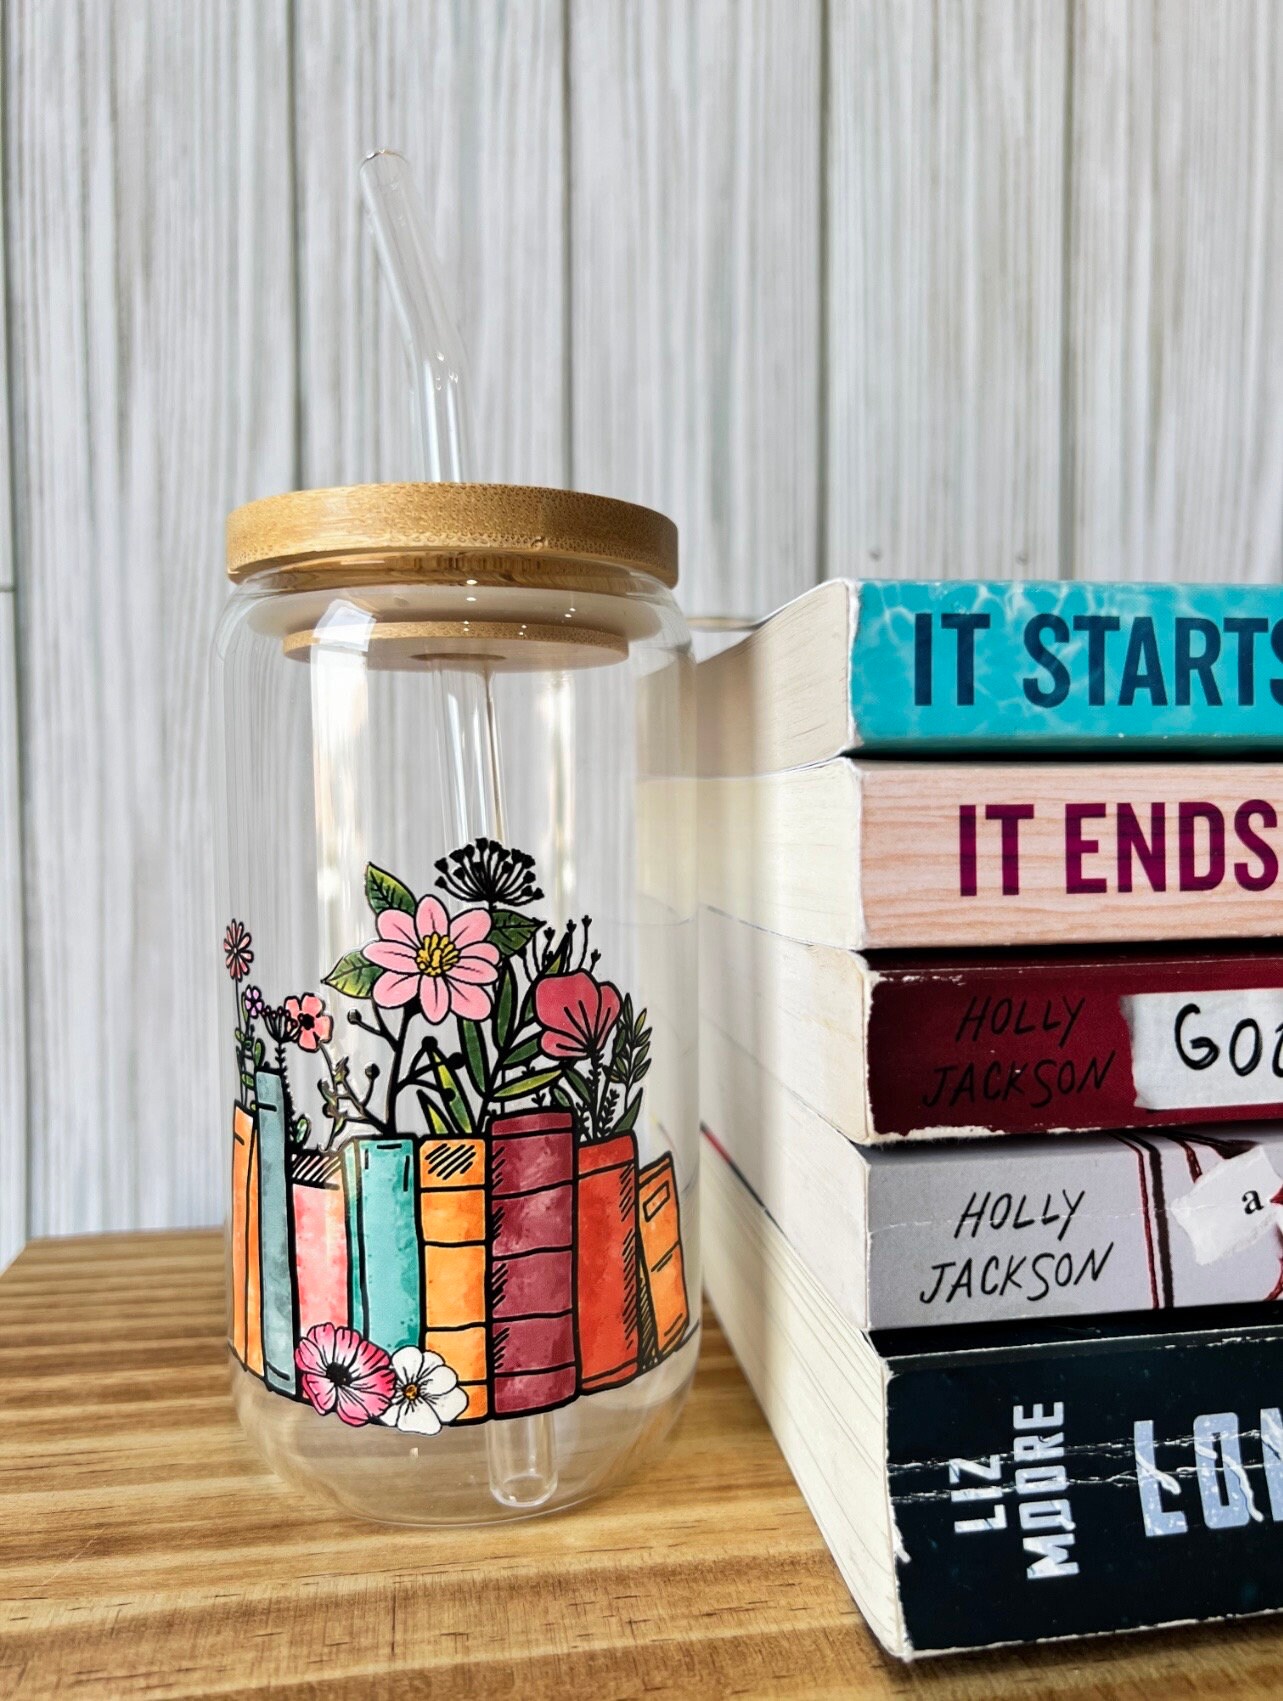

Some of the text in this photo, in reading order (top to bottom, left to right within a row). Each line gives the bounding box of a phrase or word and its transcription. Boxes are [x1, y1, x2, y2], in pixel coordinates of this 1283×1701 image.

[914, 612, 1283, 708] IT START
[958, 798, 1279, 896] IT ENDS
[954, 996, 1084, 1048] HOLLY
[921, 1050, 1117, 1109] JACKSON
[954, 1189, 1086, 1241] HOLLY
[1240, 1190, 1264, 1215] a
[919, 1242, 1115, 1304] JACKSON
[948, 1454, 1007, 1534] LIZ
[1012, 1401, 1080, 1580] MOORE
